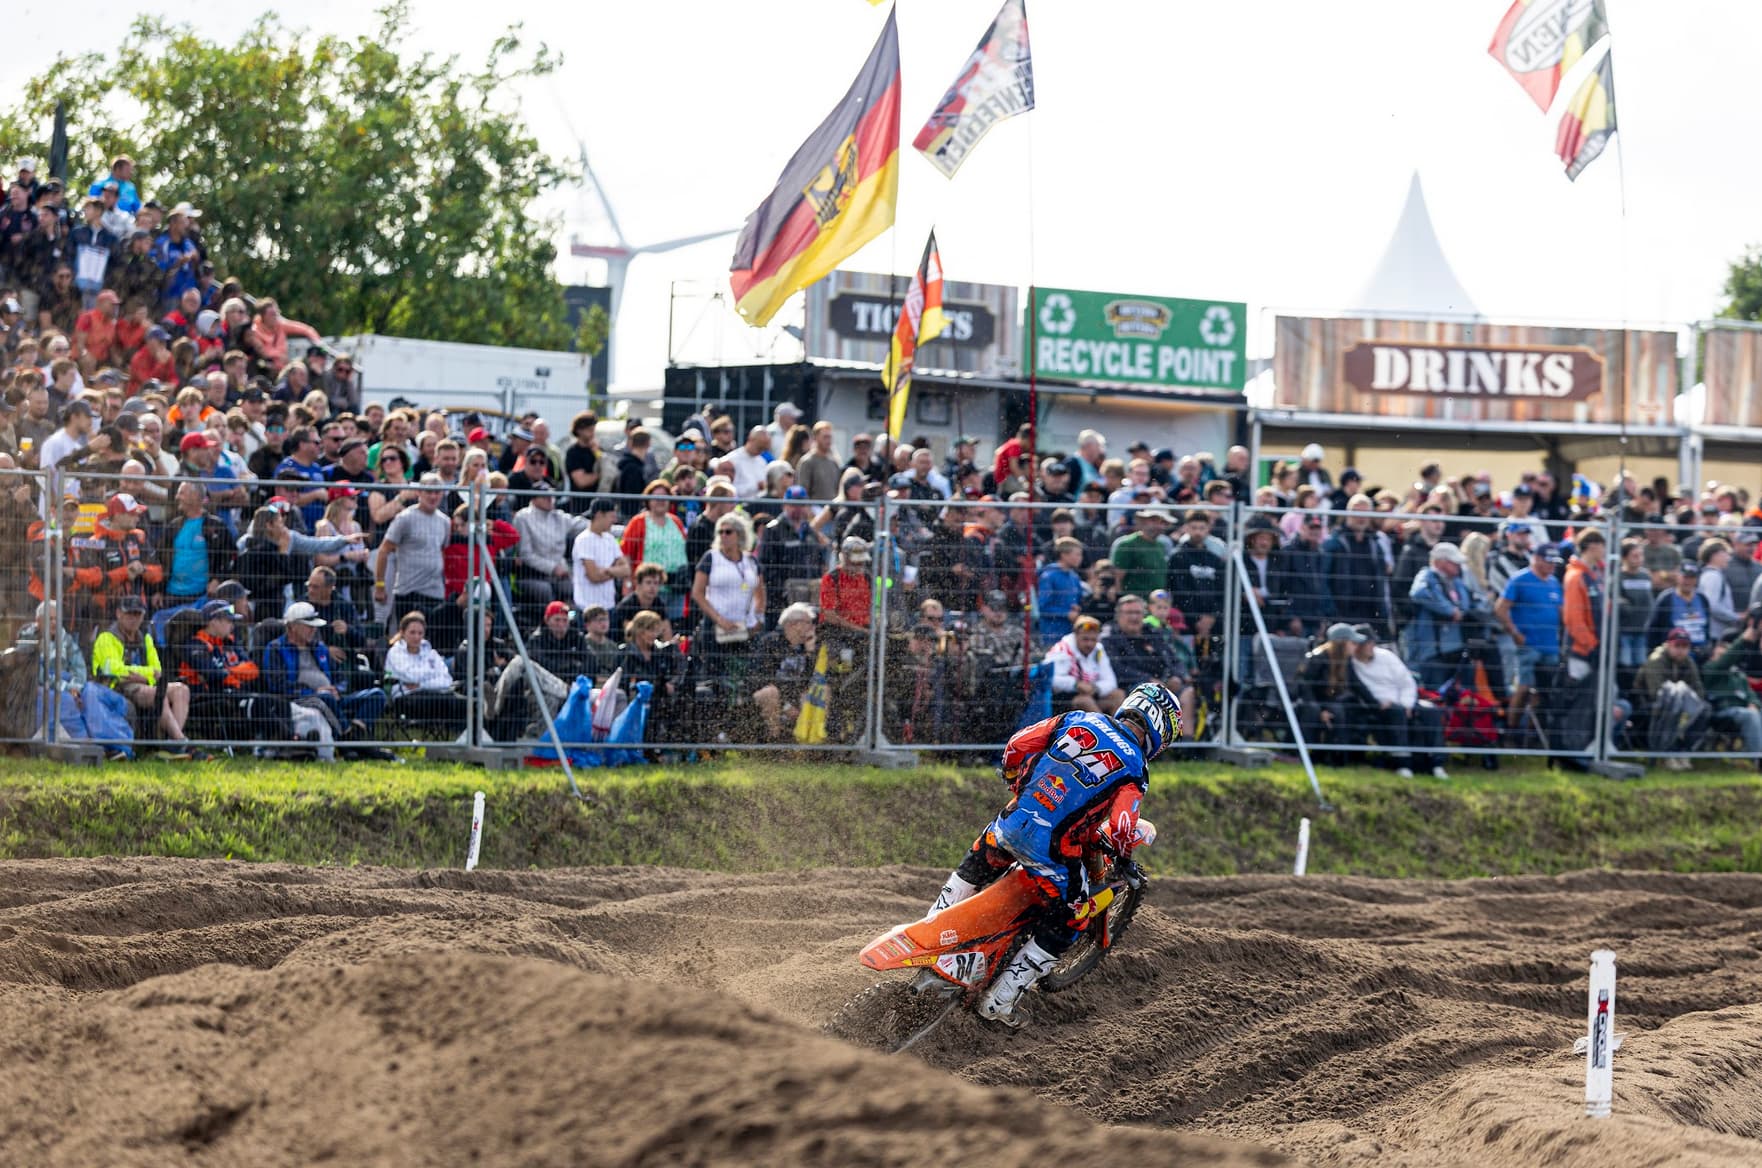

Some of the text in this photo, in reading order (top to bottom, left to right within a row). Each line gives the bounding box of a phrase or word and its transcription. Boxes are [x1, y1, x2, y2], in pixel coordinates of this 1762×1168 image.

[853, 302, 973, 341] TICTS
[1037, 336, 1236, 384] RECYCLE POINT
[1372, 346, 1575, 397] DRINKS
[1047, 726, 1126, 789] 84
[956, 952, 977, 981] 84
